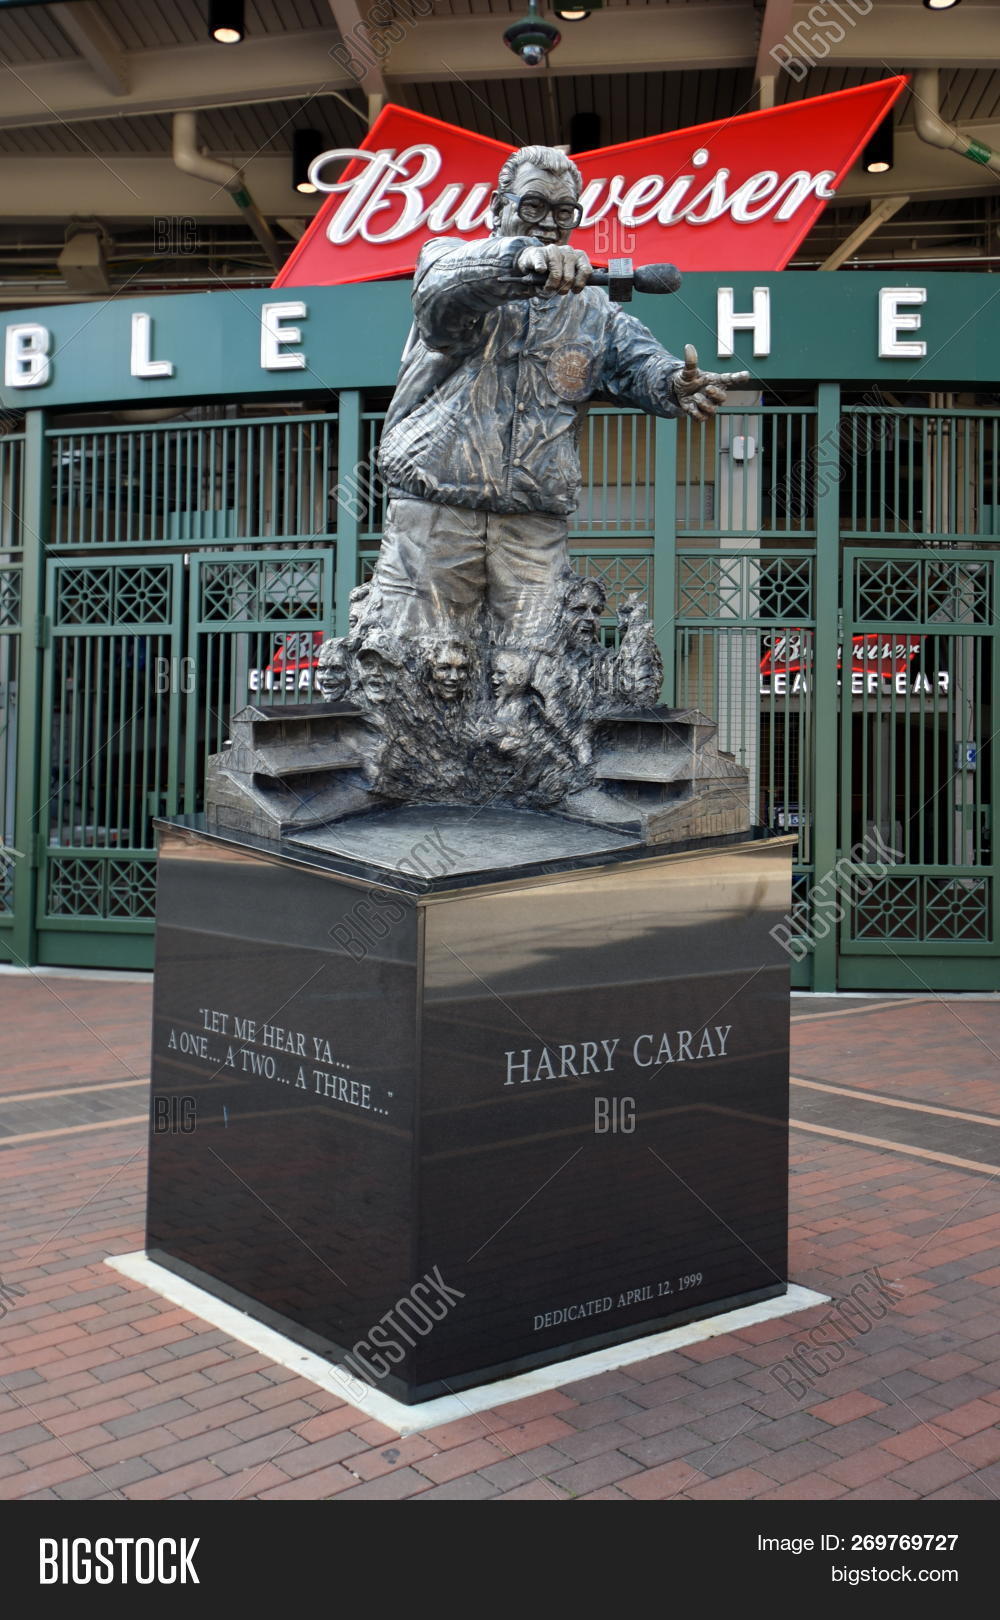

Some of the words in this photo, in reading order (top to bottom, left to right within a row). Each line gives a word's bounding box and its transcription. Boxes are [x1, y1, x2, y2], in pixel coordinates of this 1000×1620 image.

[308, 143, 836, 246] Buweiser
[167, 1028, 178, 1050] A
[179, 1031, 221, 1064] ONE...
[224, 1045, 236, 1068] A
[240, 1048, 290, 1085] TWO...
[294, 1066, 307, 1090] A
[234, 1016, 256, 1043] ME
[263, 1023, 307, 1057] HEAR
[312, 1036, 351, 1070] YA...
[503, 1038, 621, 1086] HARRY
[632, 1024, 733, 1068] CARAY
[533, 1296, 613, 1331] DEDICATED
[616, 1285, 654, 1308] APRIL
[657, 1280, 674, 1296] 12,
[677, 1272, 703, 1292] 1999
